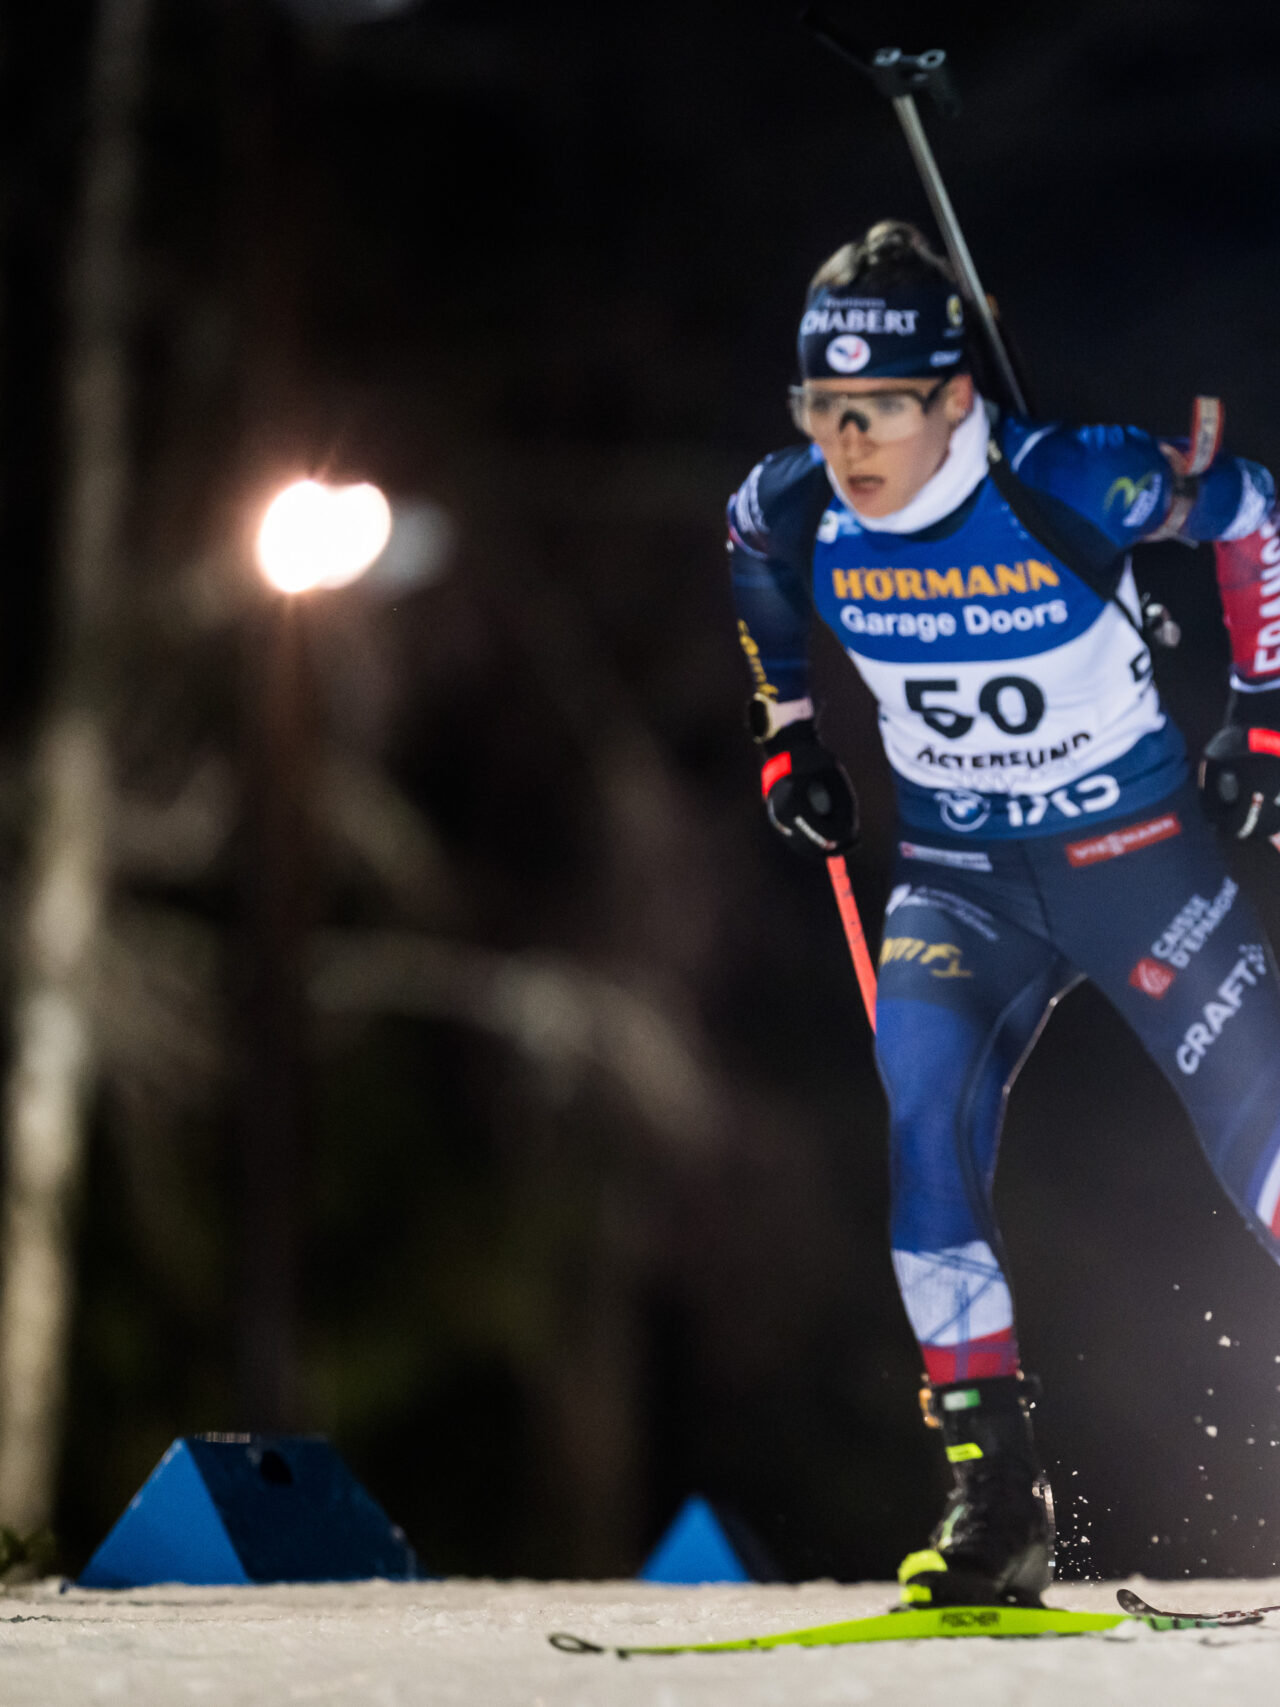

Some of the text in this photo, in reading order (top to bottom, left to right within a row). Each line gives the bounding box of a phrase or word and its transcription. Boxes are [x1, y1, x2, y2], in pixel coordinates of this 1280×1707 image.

[840, 599, 1068, 643] Garage Doors
[904, 675, 1046, 739] 50
[1176, 958, 1258, 1075] CRAFT
